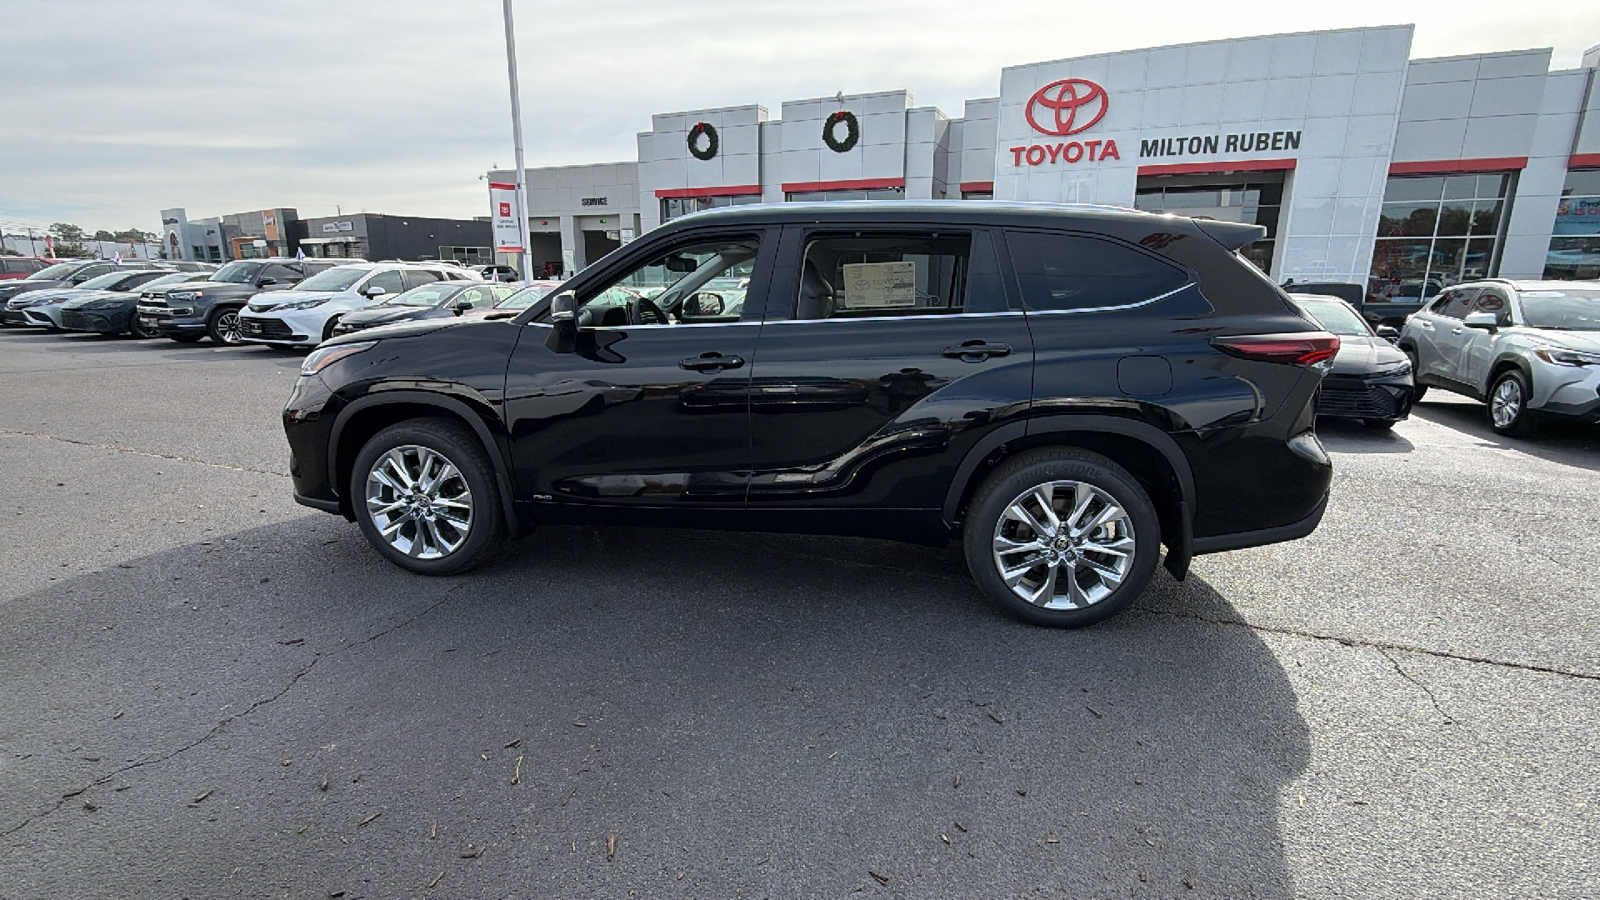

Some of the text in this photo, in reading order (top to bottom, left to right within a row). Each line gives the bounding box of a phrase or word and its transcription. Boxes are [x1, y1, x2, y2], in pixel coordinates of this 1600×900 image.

[1010, 139, 1120, 166] TOYOTA
[1139, 131, 1302, 158] MILTON RUBEN
[581, 197, 608, 206] SERVICE
